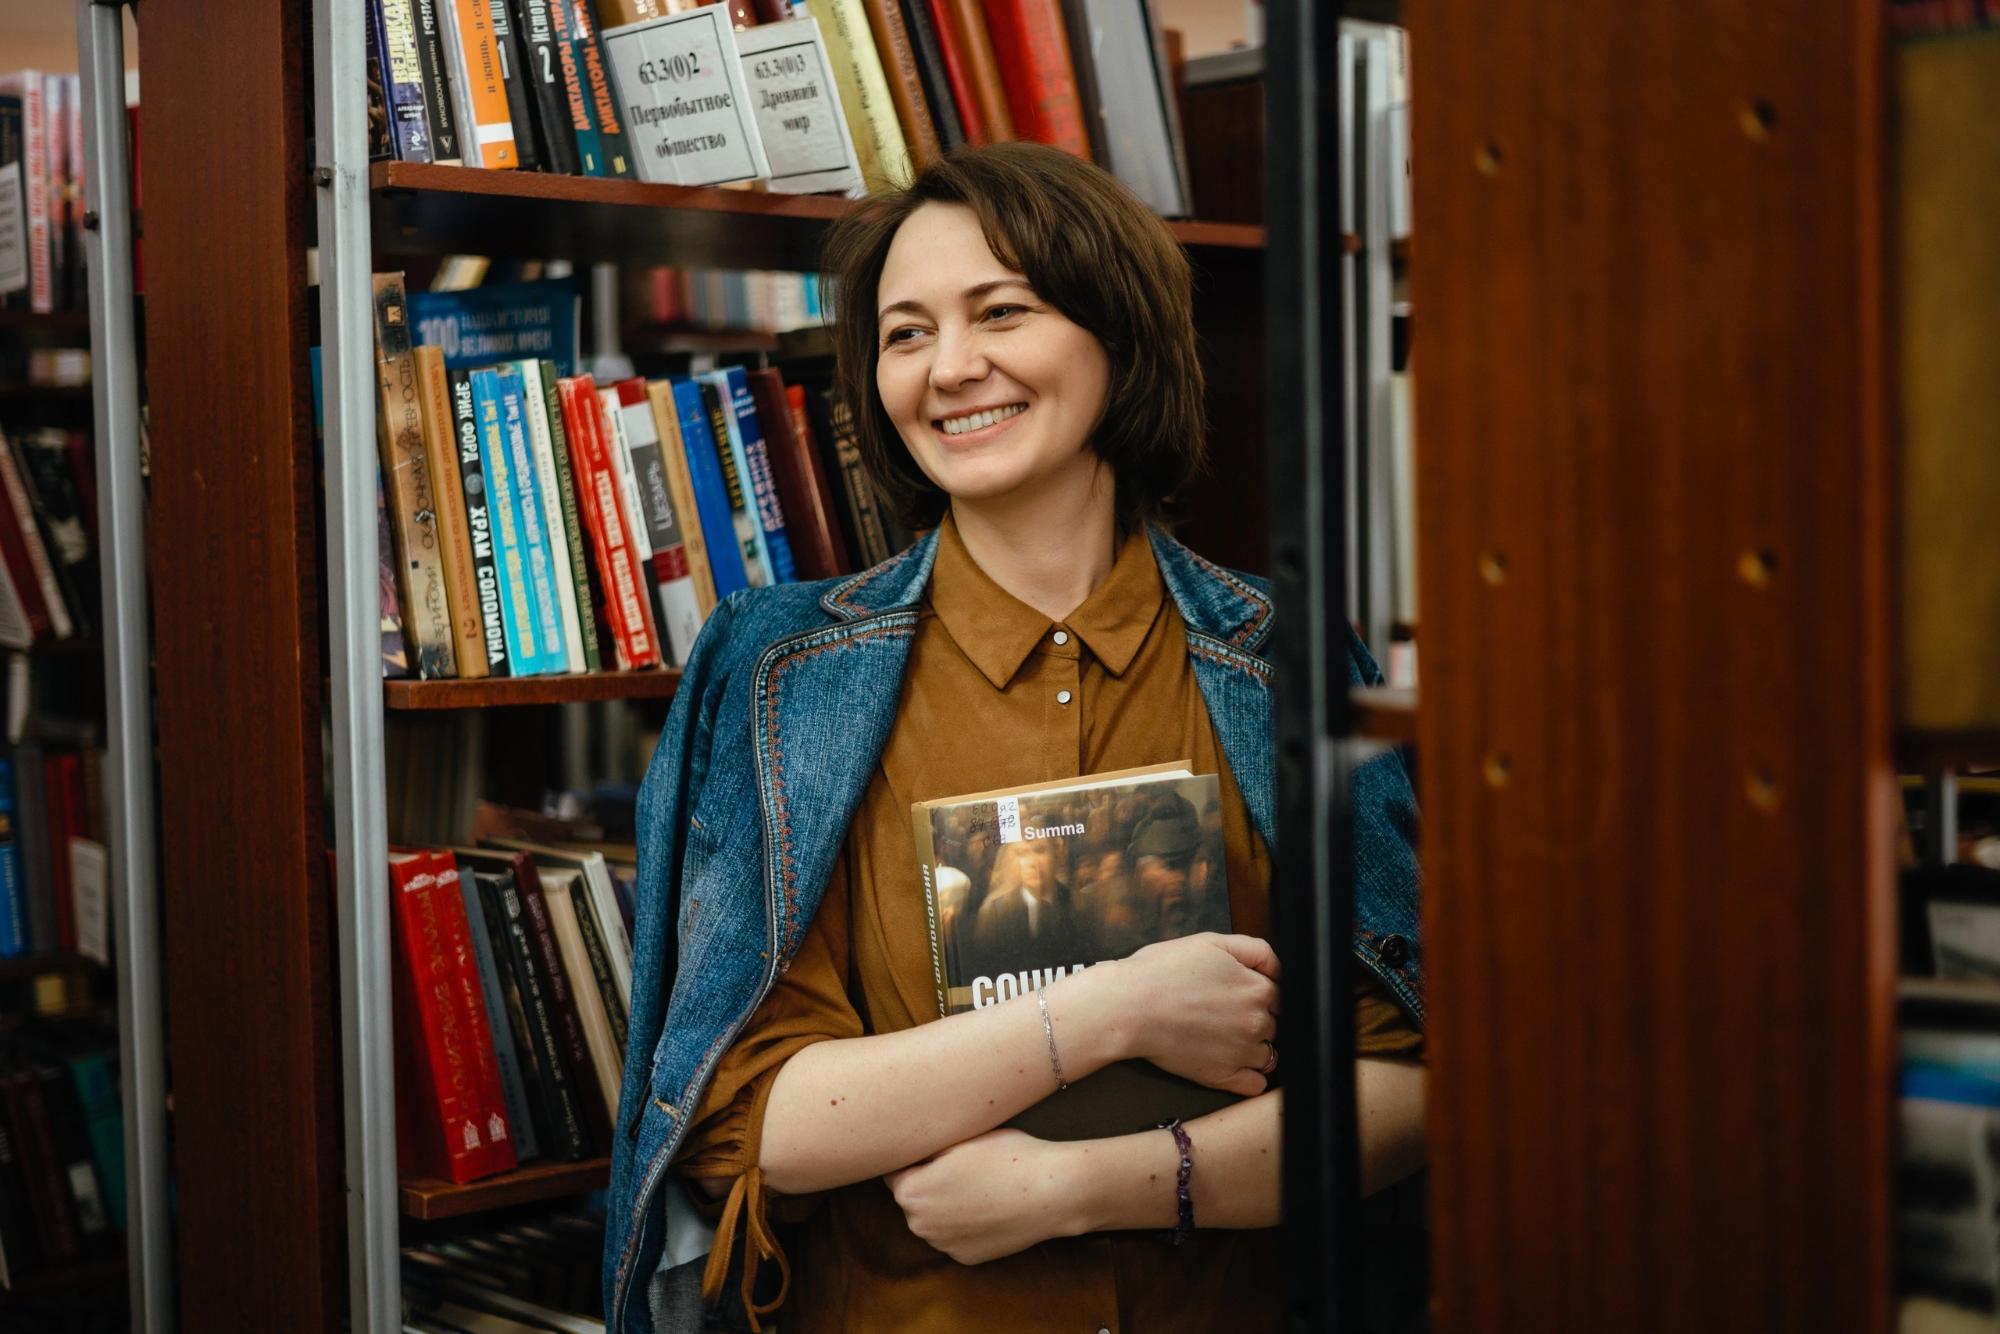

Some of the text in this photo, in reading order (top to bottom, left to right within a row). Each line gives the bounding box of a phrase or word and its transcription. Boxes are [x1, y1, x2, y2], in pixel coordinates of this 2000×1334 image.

[550, 0, 567, 32] ТИР
[383, 0, 408, 84] ВЕЛИКА
[538, 45, 555, 83] 2
[638, 52, 700, 85] 63.3(0)2
[754, 54, 806, 81] 63.3(0)3
[433, 75, 448, 128] БАСОВСКАЯ
[558, 41, 591, 130] ДИКТАТОРЫ
[583, 47, 620, 134] ДИКТАТОРЫ
[759, 82, 818, 111] Древний
[629, 92, 732, 128] Первобытное
[783, 115, 811, 134] мир
[656, 132, 727, 159] общество
[411, 456, 436, 549] СКАОЧНАЯ
[455, 382, 505, 665] ЭРИК ФОРД ХРАМ СОЛОМОНА
[463, 619, 477, 639] 2
[1024, 823, 1085, 840] Summa
[922, 863, 945, 1018] АЯ ФИЛОСОФИЯ
[972, 961, 1114, 1010] СОЦИ
